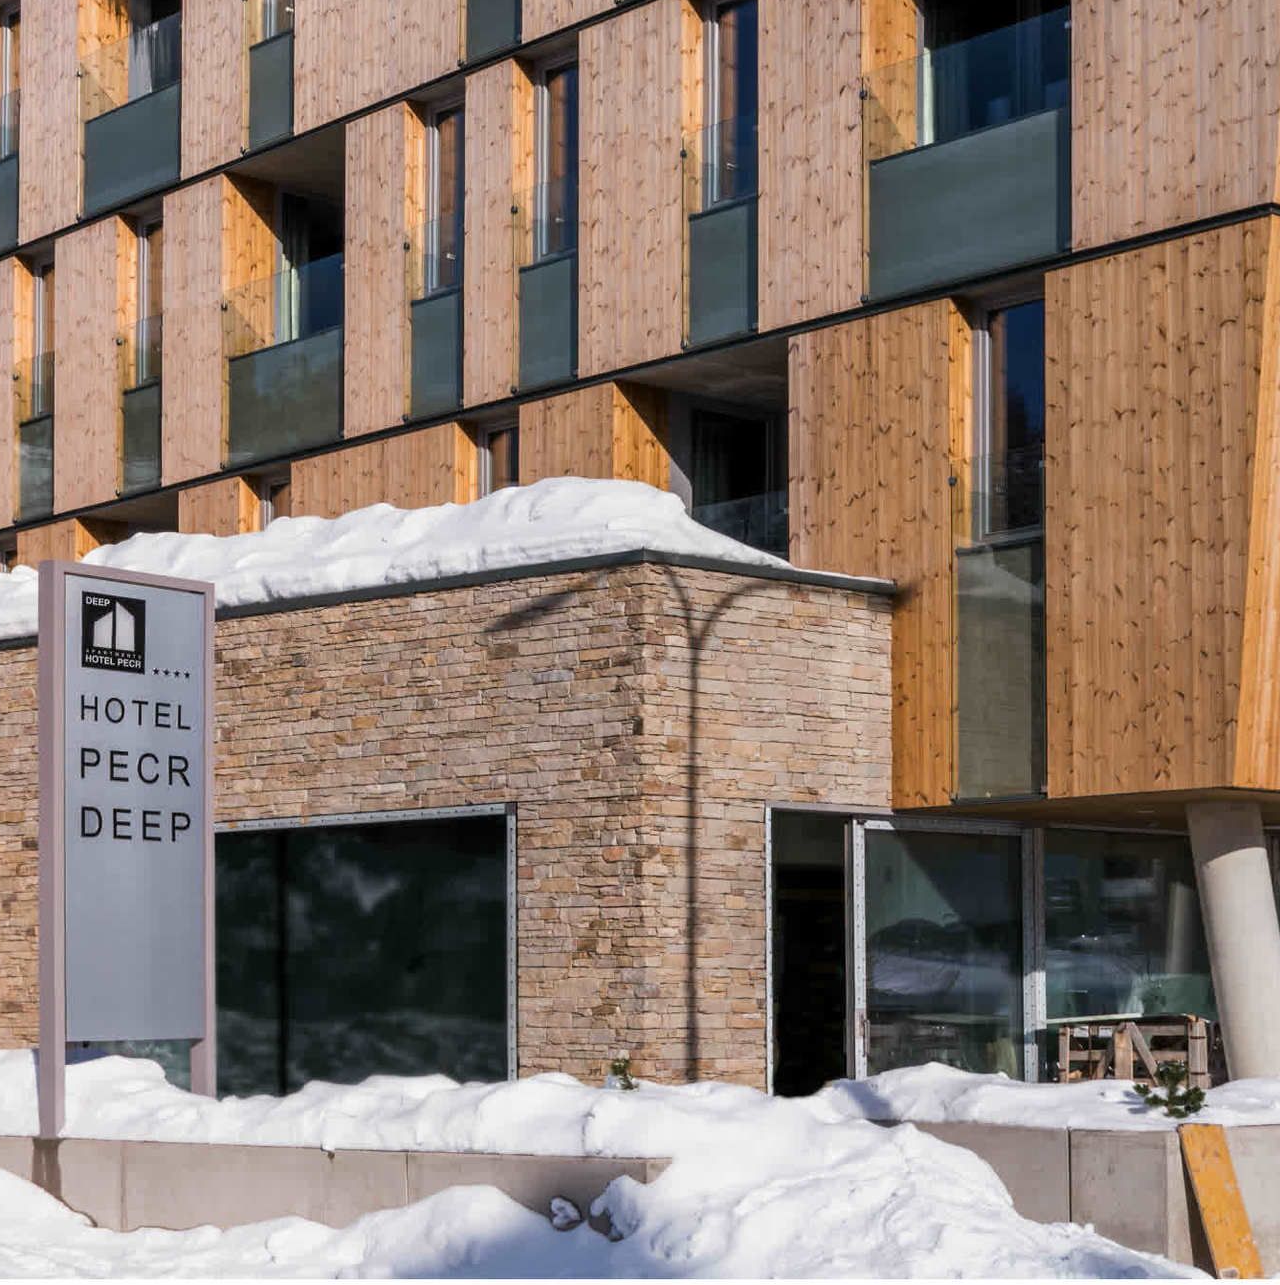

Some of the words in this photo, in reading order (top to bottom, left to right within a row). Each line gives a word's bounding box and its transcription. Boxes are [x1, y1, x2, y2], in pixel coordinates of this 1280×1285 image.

[85, 596, 111, 607] DEEP
[85, 654, 116, 666] HOTEL
[117, 658, 142, 669] PECR
[80, 694, 192, 730] HOTEL
[80, 747, 191, 787] PECR
[80, 806, 191, 842] DEEP
